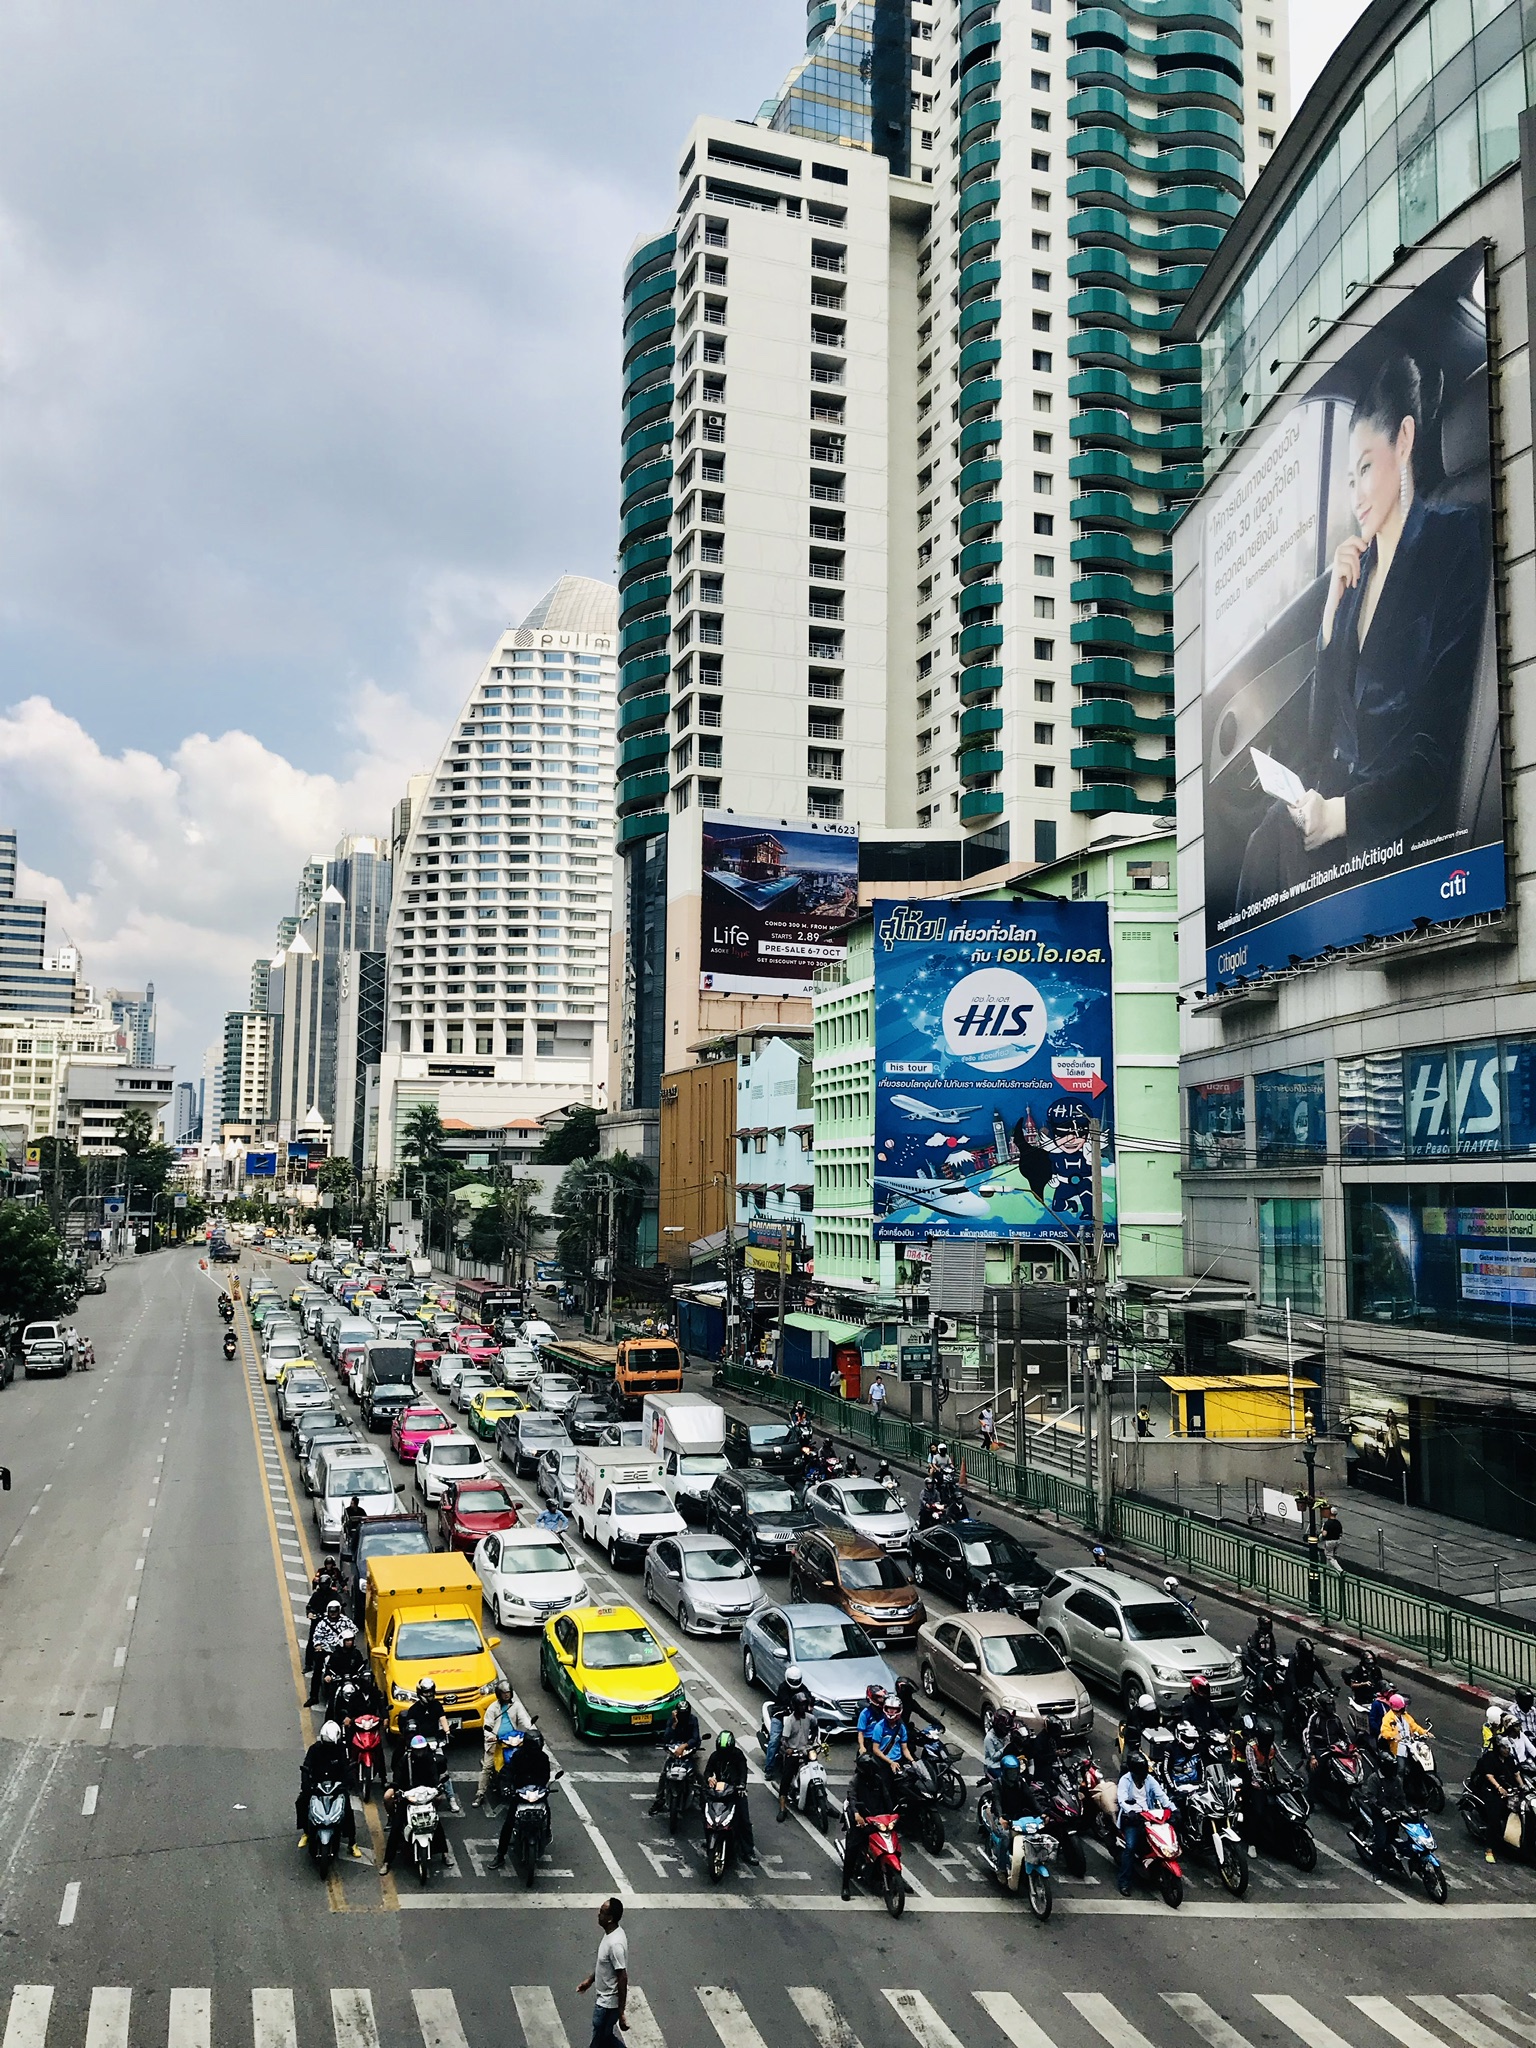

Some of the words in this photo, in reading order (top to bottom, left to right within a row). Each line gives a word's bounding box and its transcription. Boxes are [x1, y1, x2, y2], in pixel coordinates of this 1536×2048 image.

[1240, 512, 1250, 537] 30
[1216, 590, 1240, 620] CITIGOLD
[541, 633, 610, 648] pullm
[1242, 893, 1278, 920] 0-2081-0999
[1290, 838, 1404, 898] www.citibank.co.th/citigold
[1440, 873, 1466, 899] citi
[714, 925, 749, 946] Life
[797, 932, 819, 942] 2.89
[948, 920, 1037, 942] เที่ยวทั่วโลก
[765, 945, 805, 953] PRE-SALE
[971, 950, 990, 962] กับ
[996, 942, 1106, 964] เอช.ไอ.เอส.
[1218, 944, 1248, 975] Citigold
[890, 1062, 904, 1071] his
[907, 1064, 927, 1072] tour
[878, 1078, 943, 1091] เที่ยวรอบโลกอุ่นใจ
[943, 1079, 973, 1089] ไปกับเรา
[975, 1078, 1053, 1089] พร้อมให้บริการทั่วโลก
[1072, 1080, 1093, 1089] ทางนี้
[1402, 1142, 1422, 1154] Lve
[1425, 1142, 1451, 1154] Peac
[1457, 1140, 1499, 1153] TRAVEL
[878, 1226, 914, 1237] ตั๋วเครื่องบิน
